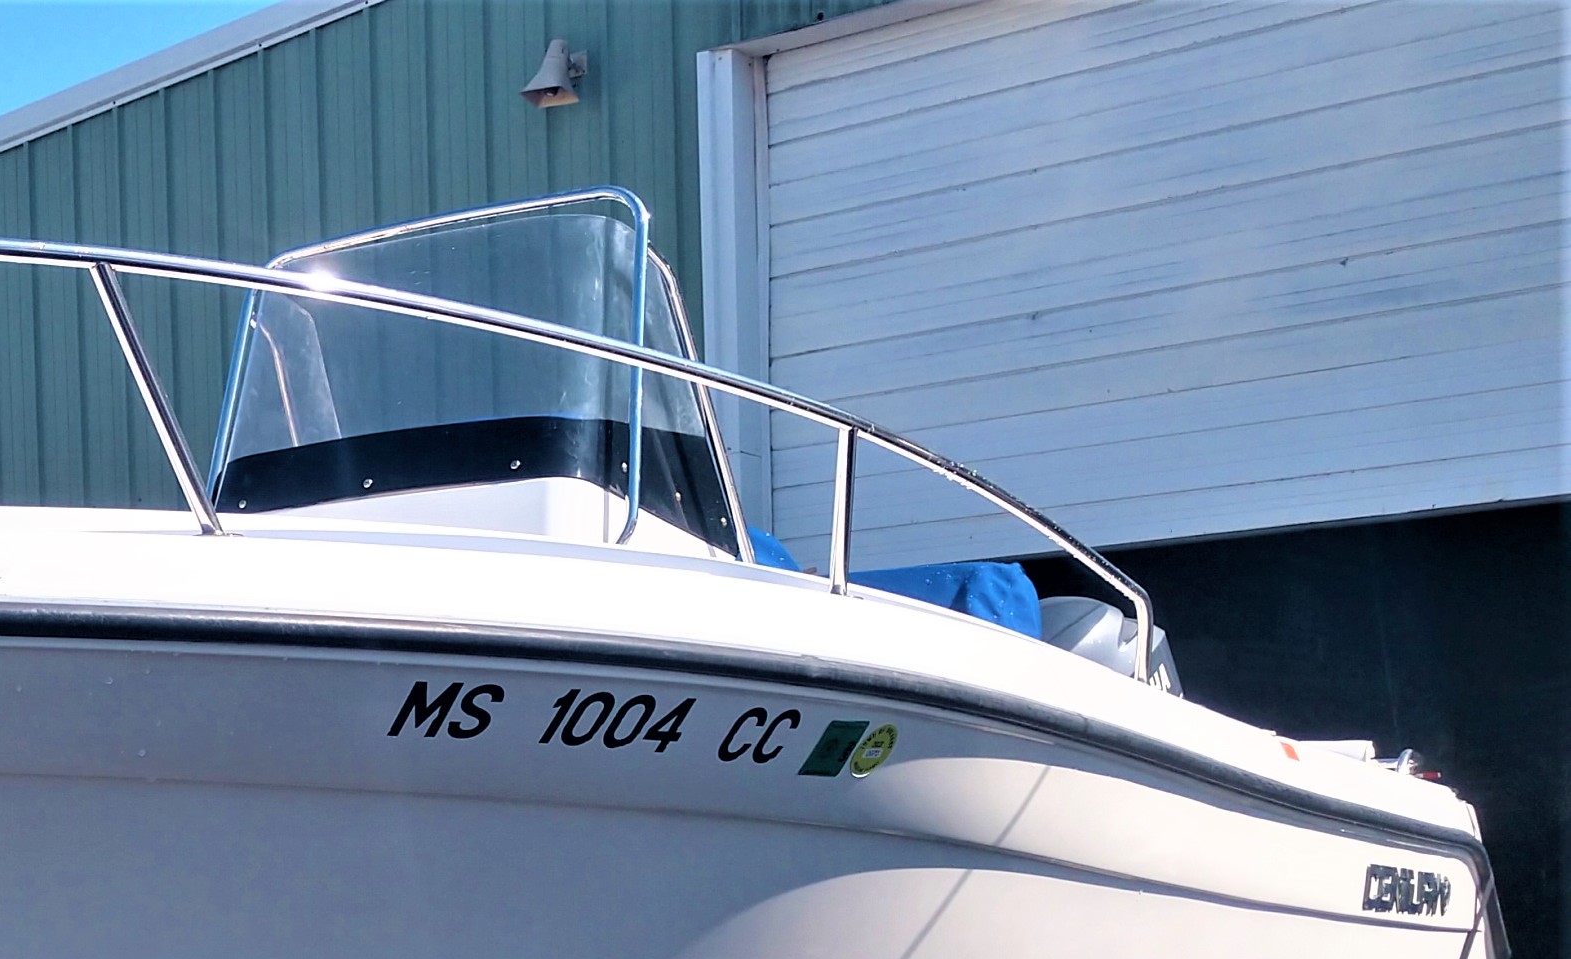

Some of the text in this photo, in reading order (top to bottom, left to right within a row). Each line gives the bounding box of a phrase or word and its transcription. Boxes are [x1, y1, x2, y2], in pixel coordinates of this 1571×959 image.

[387, 681, 801, 764] MS 1004 CC
